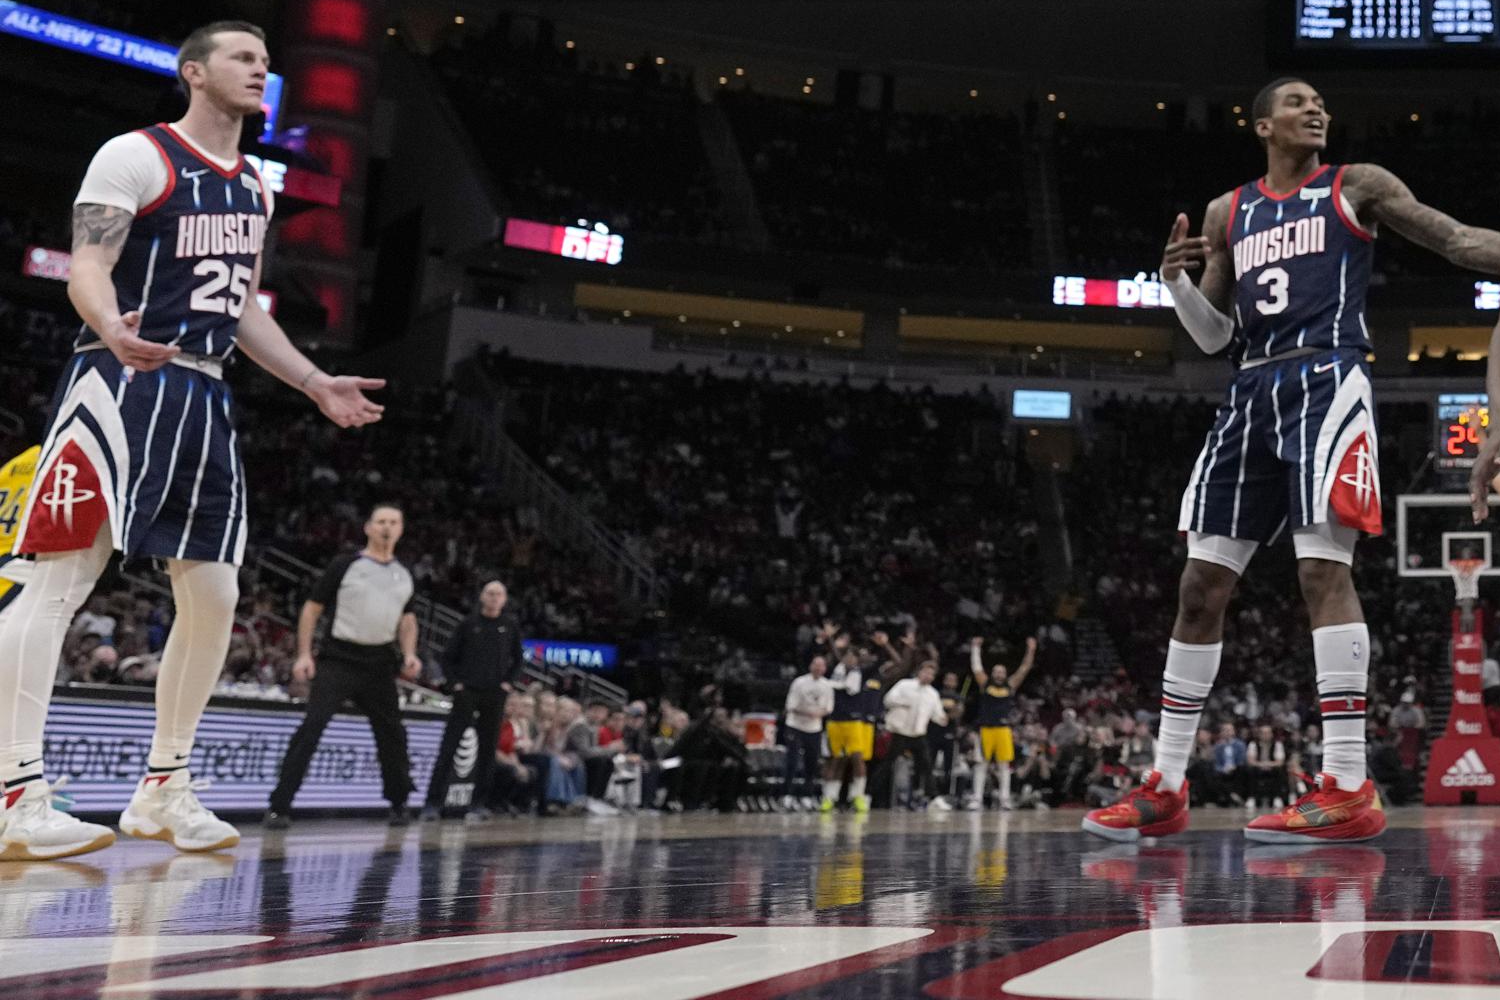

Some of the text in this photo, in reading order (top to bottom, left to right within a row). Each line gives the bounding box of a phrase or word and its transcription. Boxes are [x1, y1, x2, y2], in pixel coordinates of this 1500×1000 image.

[1233, 215, 1326, 281] HOUSTON
[190, 259, 253, 319] 25
[1255, 267, 1290, 315] 3
[545, 647, 604, 668] ULTRA
[1440, 773, 1496, 787] adidas
